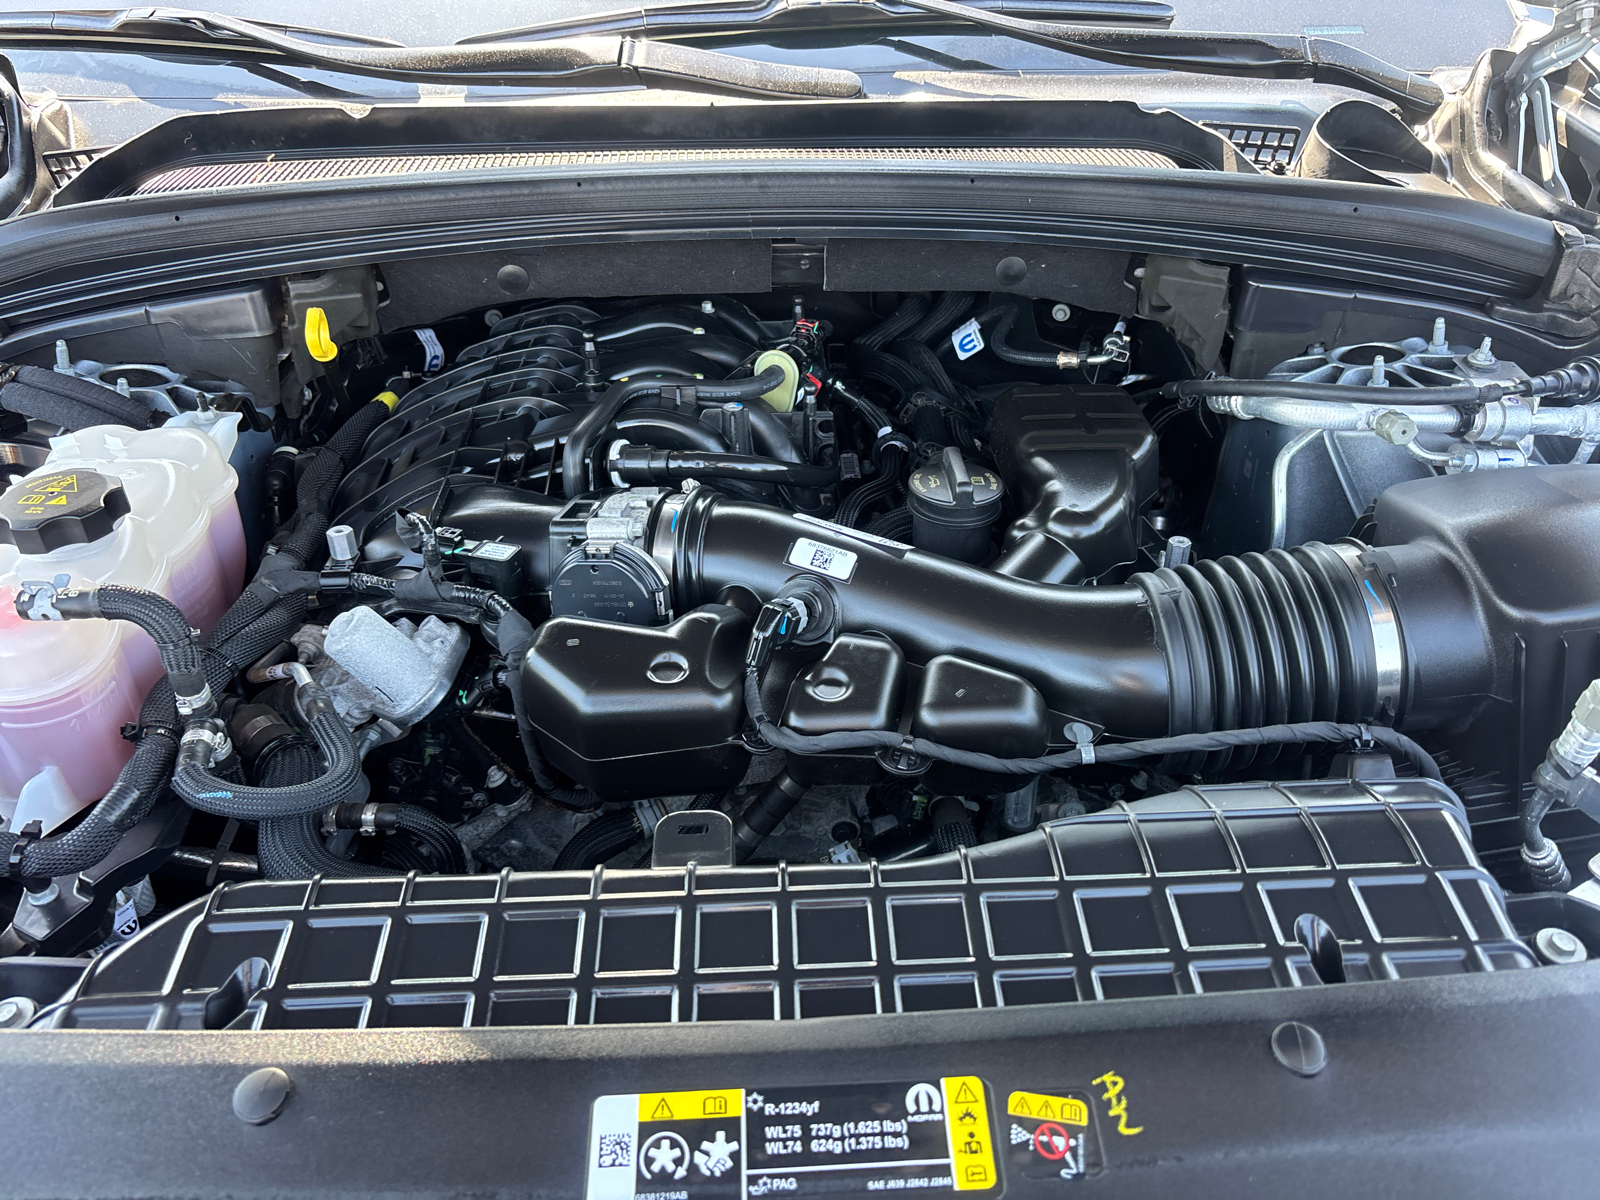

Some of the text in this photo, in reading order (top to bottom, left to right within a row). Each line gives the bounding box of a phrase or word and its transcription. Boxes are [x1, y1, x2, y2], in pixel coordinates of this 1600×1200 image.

[764, 1100, 820, 1116] R-1234yf
[764, 1118, 908, 1139] WL75 737g (1.625 lbs)
[765, 1134, 910, 1155] WL74 624g (1.375 lbs)
[772, 1177, 798, 1190] PAG
[867, 1180, 886, 1190] SAE
